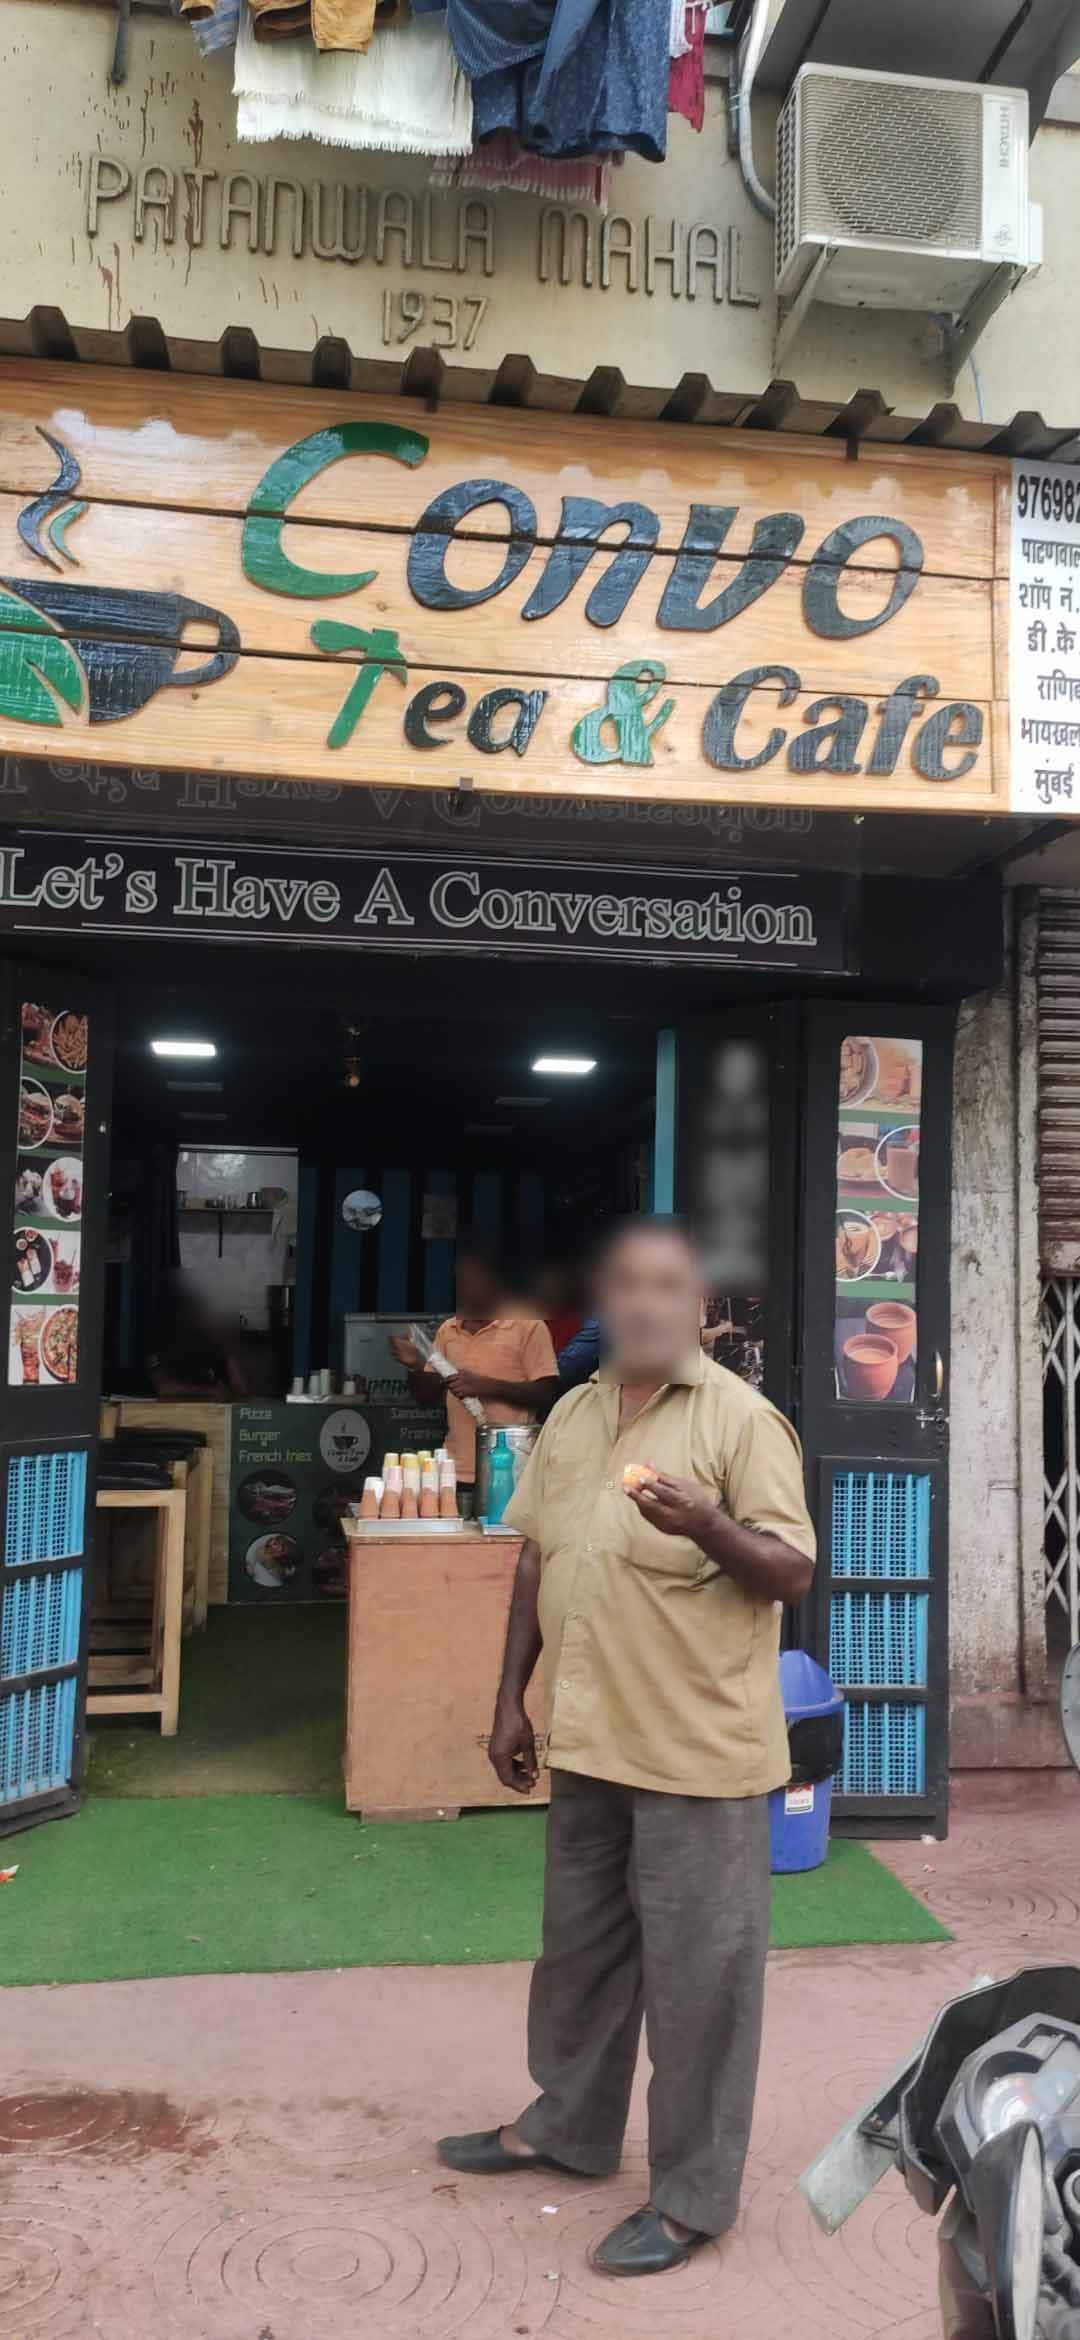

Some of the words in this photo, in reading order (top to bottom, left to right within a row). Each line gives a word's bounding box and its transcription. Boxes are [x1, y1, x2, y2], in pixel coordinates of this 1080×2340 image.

[999, 105, 1010, 168] HITACHI
[87, 152, 497, 277] PATANWALA
[537, 206, 760, 307] MAHAL
[382, 288, 489, 350] 1937
[240, 421, 926, 642] Convo
[310, 619, 548, 754] Tea
[573, 658, 675, 768] &
[703, 664, 985, 781] Cafe
[1033, 758, 1075, 805] मुंबई
[0, 847, 158, 913] Let’s
[173, 857, 341, 923] Have
[354, 868, 415, 926] A
[430, 871, 817, 946] Conversation
[239, 1407, 273, 1420] Pizza
[239, 1428, 281, 1447] Burger
[239, 1448, 282, 1462] French
[286, 1448, 313, 1462] fries
